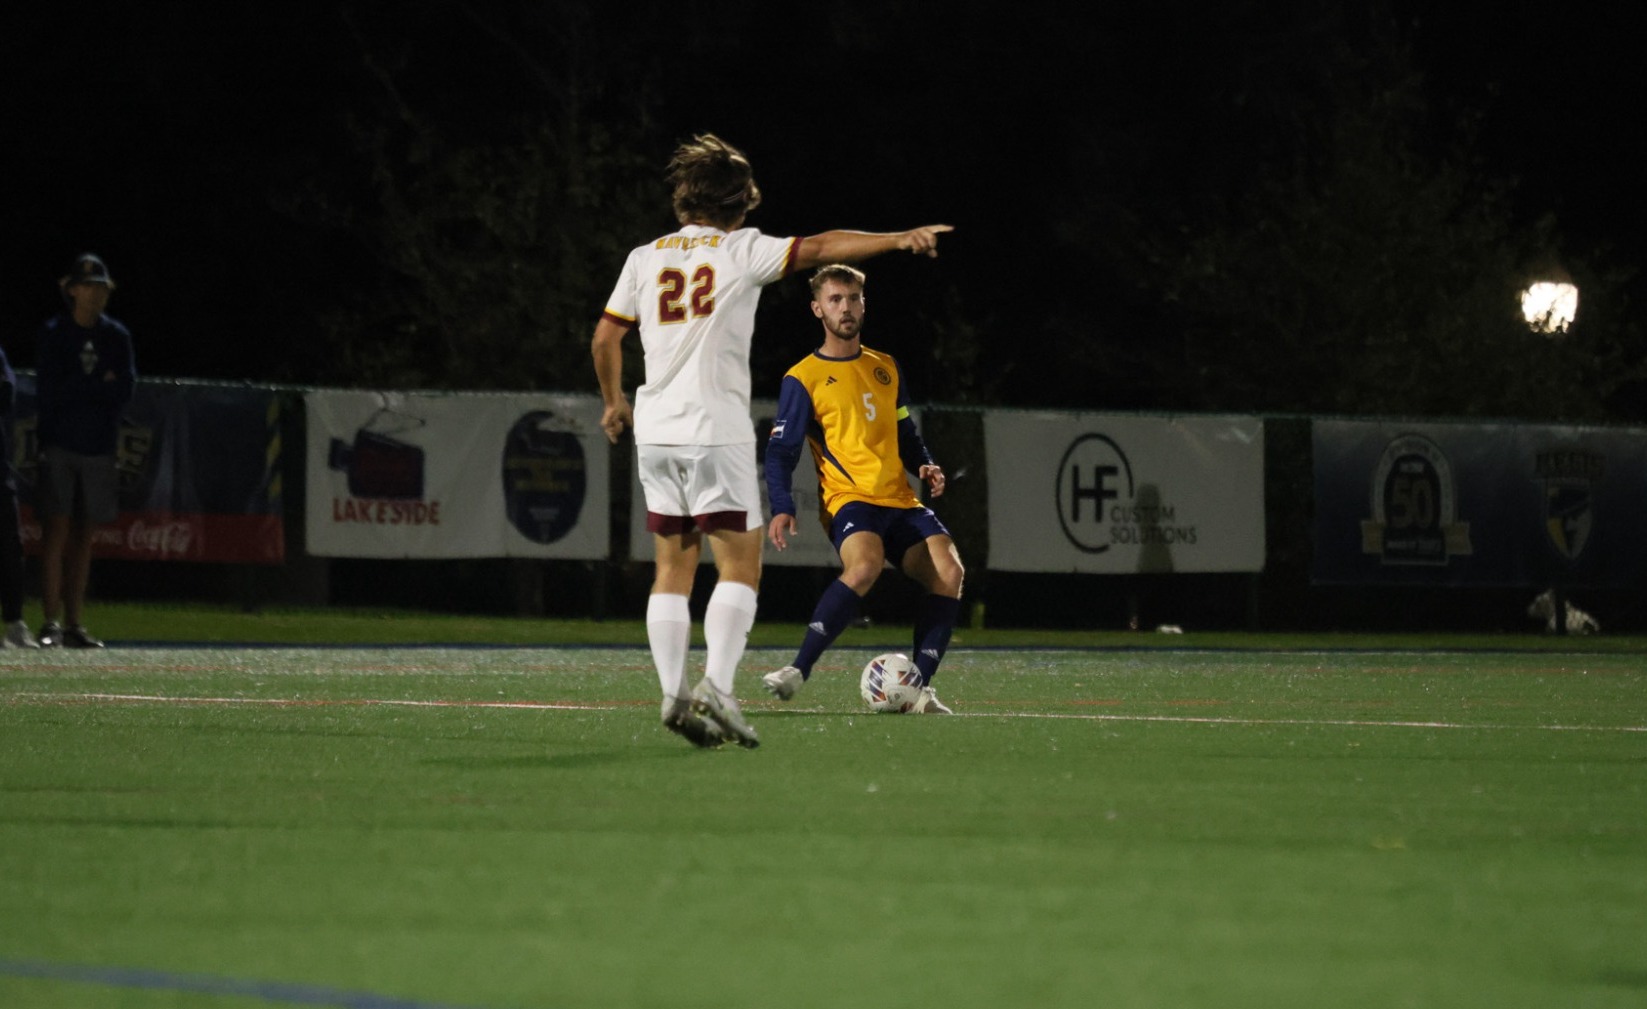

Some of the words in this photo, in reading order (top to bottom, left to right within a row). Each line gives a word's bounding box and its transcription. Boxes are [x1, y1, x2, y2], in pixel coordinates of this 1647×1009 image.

[657, 262, 716, 325] 22
[862, 392, 877, 422] 5
[333, 498, 440, 526] LAKESIDE
[1110, 506, 1176, 523] CUSTOM
[1390, 476, 1434, 529] 50
[1110, 526, 1198, 545] SOLUTIONS
